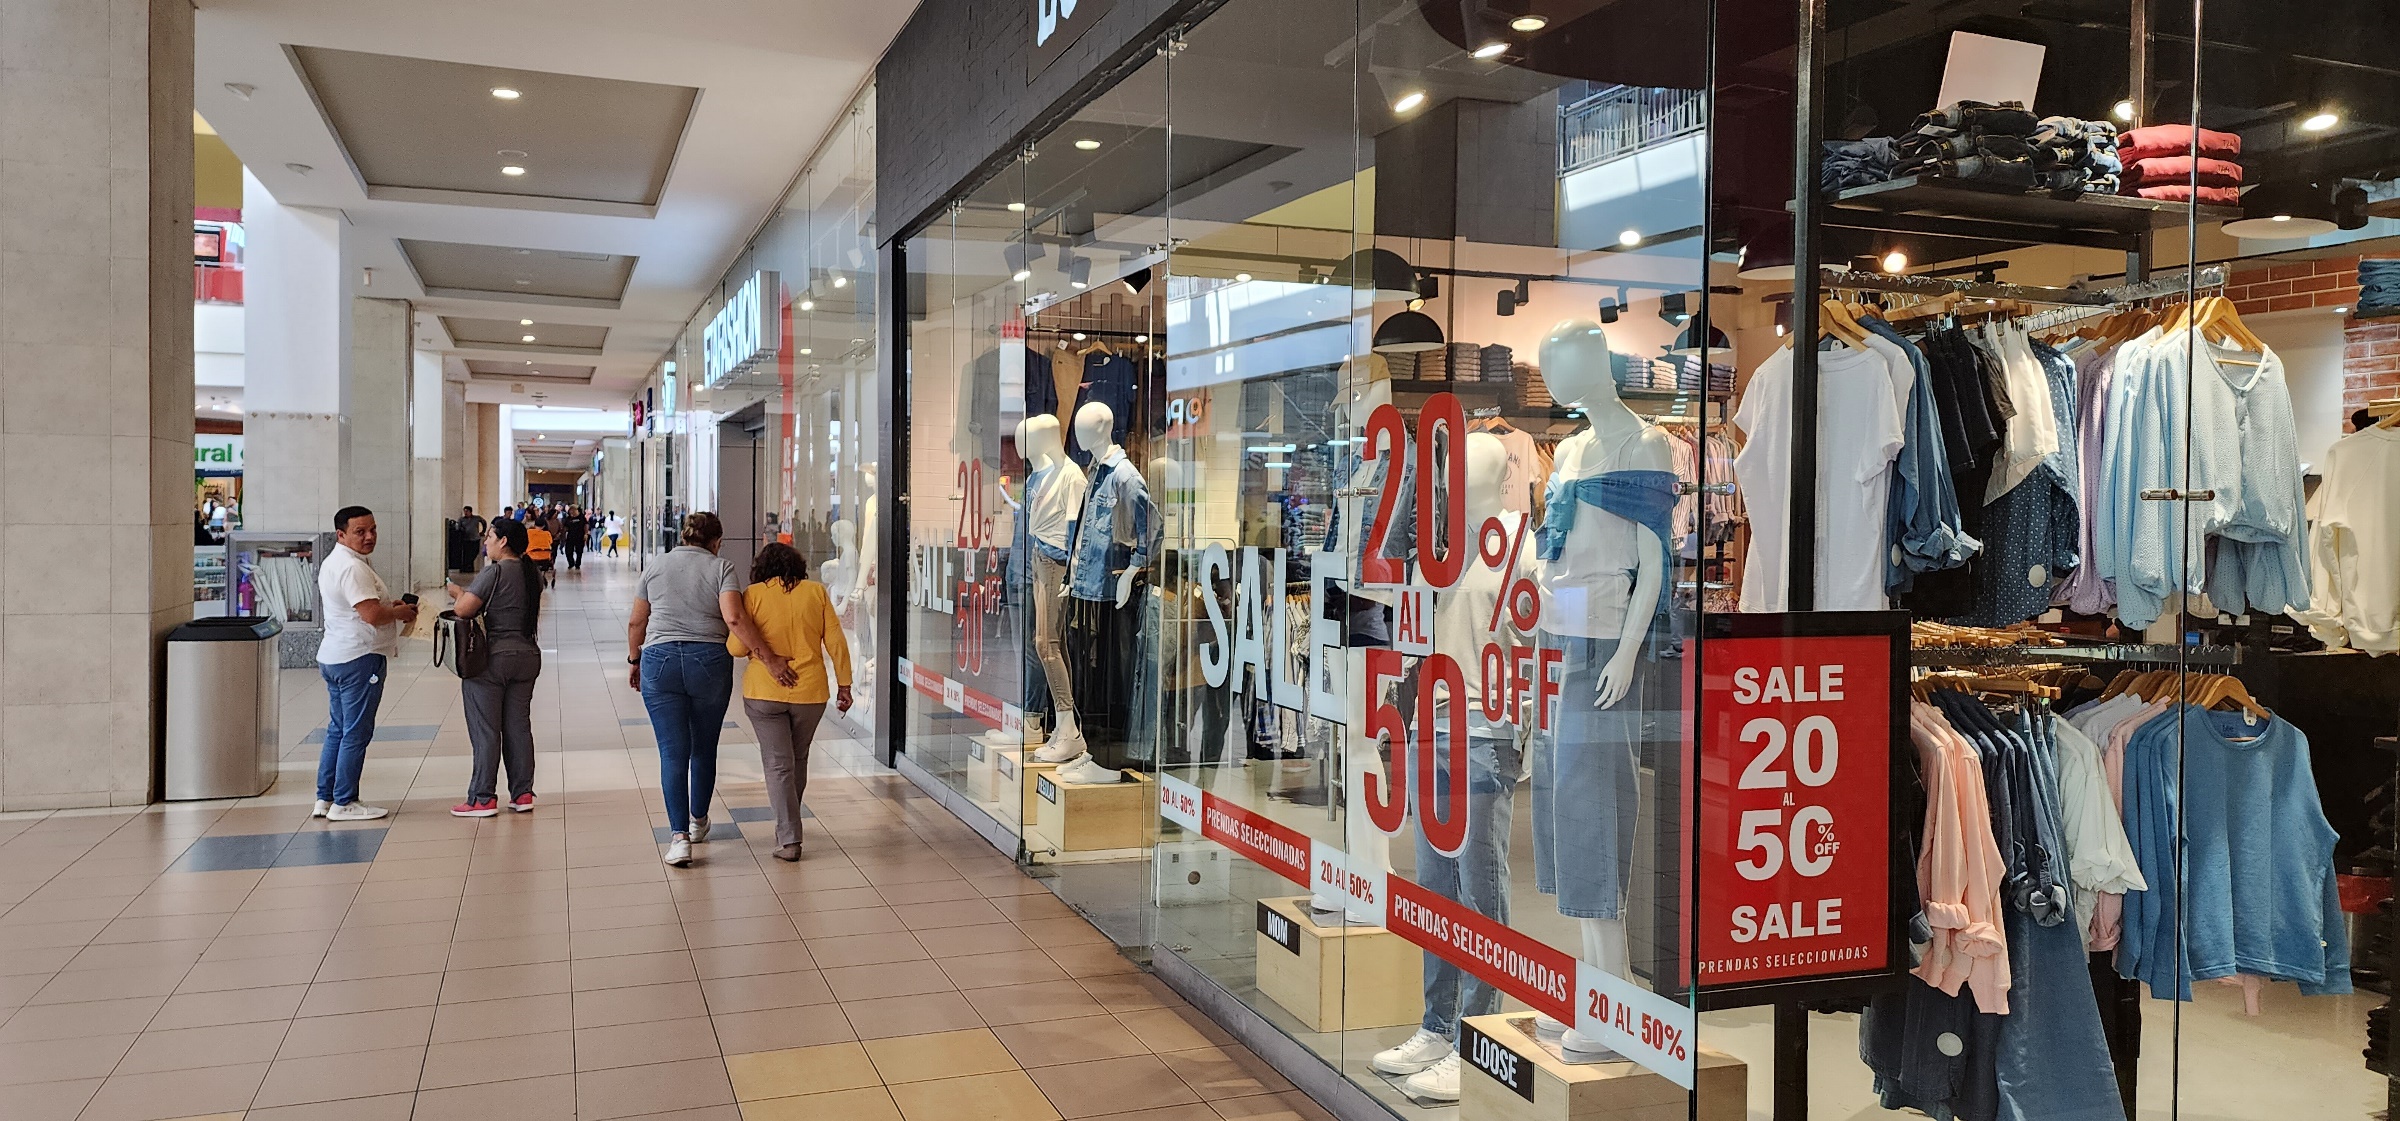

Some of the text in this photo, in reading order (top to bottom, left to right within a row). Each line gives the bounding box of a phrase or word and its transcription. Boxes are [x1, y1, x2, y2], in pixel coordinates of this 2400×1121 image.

[958, 458, 982, 552] 20
[1362, 392, 1467, 591] 20
[911, 527, 953, 615] SALE
[984, 576, 1002, 615] OFF
[957, 580, 982, 676] 50
[1200, 541, 1348, 724] SALE
[1399, 590, 1428, 644] AL
[1481, 642, 1564, 736] OFF
[1733, 664, 1844, 705] SALE
[1364, 648, 1469, 858] 50
[1738, 715, 1839, 790] 20
[1783, 792, 1795, 807] AL
[1735, 805, 1834, 881] 50
[1814, 842, 1841, 856] OFF
[1163, 786, 1169, 805] 20
[1171, 791, 1178, 809] AL
[1181, 794, 1195, 817] 50%
[1207, 807, 1239, 839] PRENDAS
[1241, 822, 1306, 871] SELECCIONADAS
[1321, 860, 1332, 884] 20
[1349, 873, 1374, 905] 50%
[1394, 893, 1449, 942] PRENDAS
[1452, 921, 1567, 1002] SELECCIONADAS
[1589, 988, 1608, 1024] 20
[1615, 1001, 1635, 1037] AL
[1642, 1012, 1686, 1062] 50%
[1267, 910, 1288, 946] MOM
[1730, 898, 1842, 943] SALE
[1699, 946, 1869, 975] PRENDAS SELECCIONADAS
[1473, 1031, 1518, 1089] LOOSE
